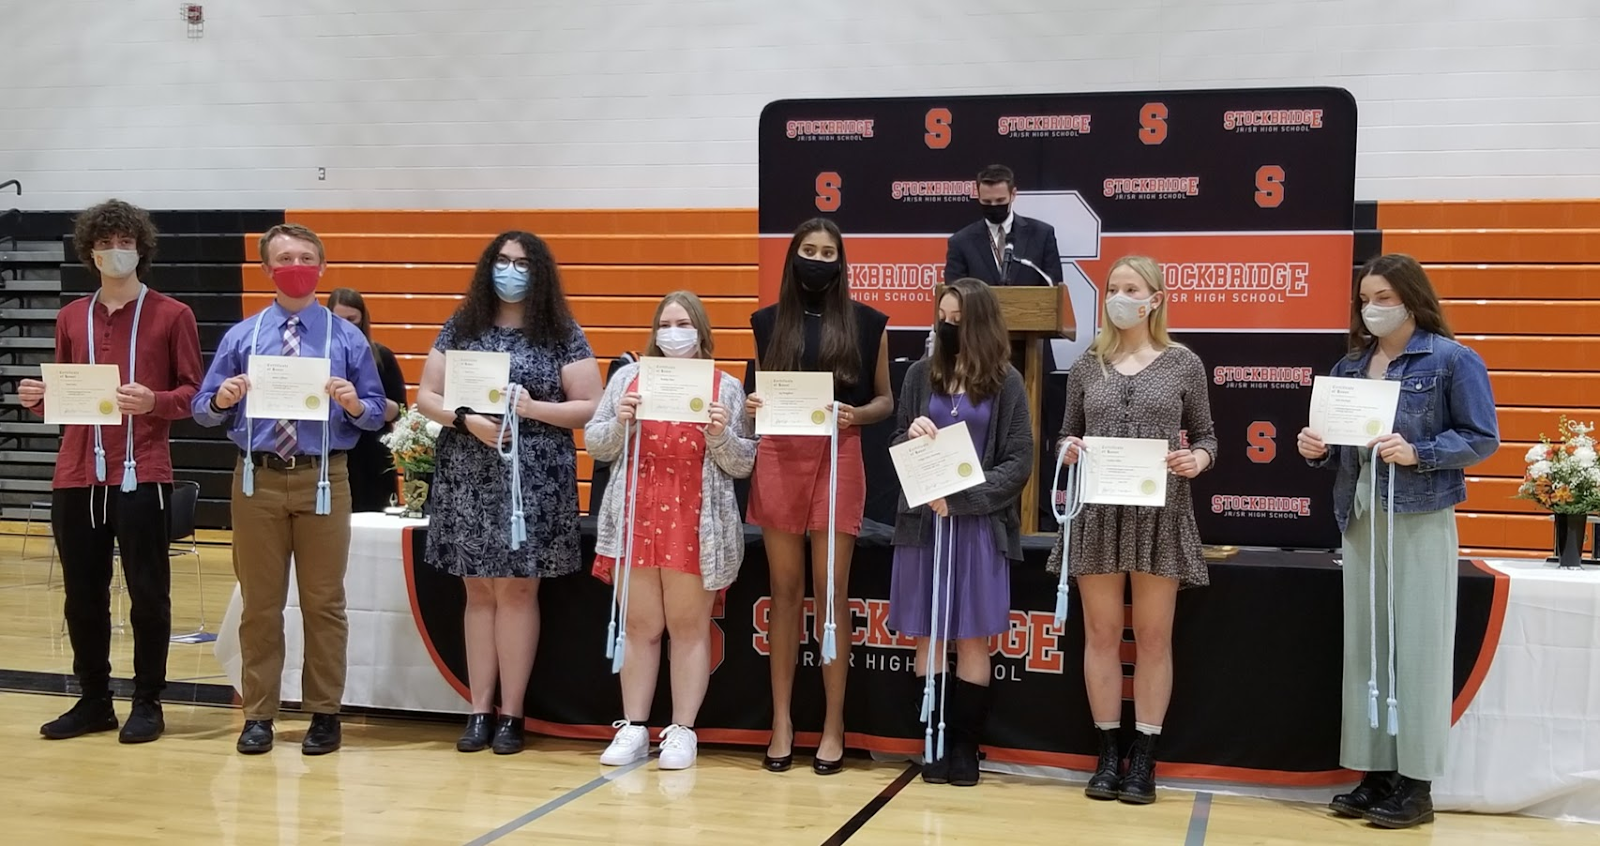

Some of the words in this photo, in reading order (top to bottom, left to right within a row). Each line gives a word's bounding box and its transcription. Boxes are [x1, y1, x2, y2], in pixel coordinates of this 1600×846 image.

[786, 120, 874, 138] STOCKBRIDGE
[925, 108, 952, 149] S
[998, 115, 1091, 135] STOCKBRIDGE
[1139, 102, 1168, 145] S
[1224, 109, 1323, 130] STOCKBRIDGE
[815, 172, 842, 212] S
[1104, 177, 1199, 196] STOCKBRIDGE
[1254, 165, 1285, 208] S
[847, 264, 946, 292] KBRIDG
[1158, 262, 1309, 296] OCKBRIDGE
[851, 292, 878, 301] HIGH
[885, 293, 931, 301] SCHOOL
[1195, 293, 1225, 302] HIGH
[1233, 293, 1284, 302] SCHOOL
[1214, 366, 1312, 386] STOCKBRIDGE
[1246, 421, 1276, 463] S
[1212, 494, 1310, 516] STOCKBRIDGE
[866, 653, 916, 672] HIGH
